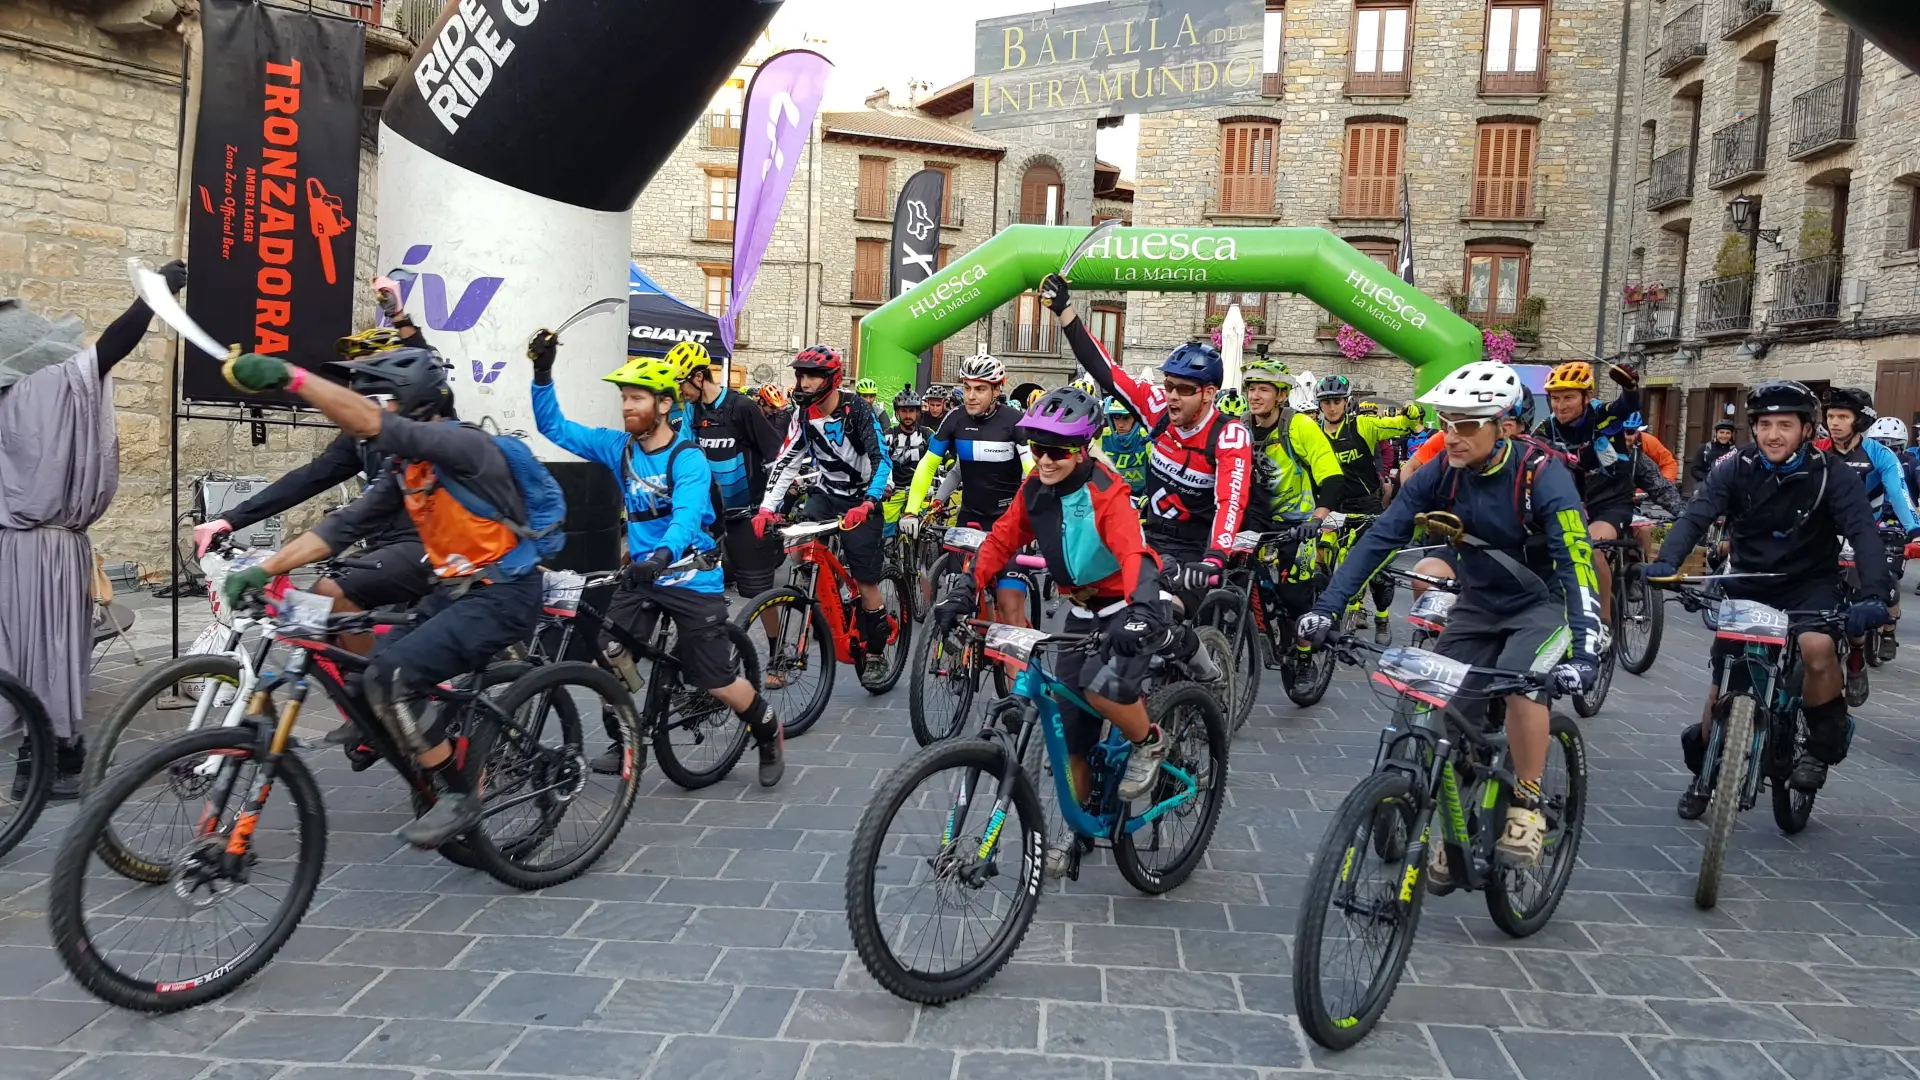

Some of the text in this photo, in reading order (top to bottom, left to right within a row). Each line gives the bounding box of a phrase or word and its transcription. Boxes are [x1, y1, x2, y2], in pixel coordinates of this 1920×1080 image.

[1001, 13, 1247, 71] BATALLA DEL
[1031, 17, 1049, 31] LA
[428, 15, 516, 135] RIDE
[980, 55, 1255, 117] INFRAMUNDO
[220, 143, 238, 260] Zona Zero Official Beer
[243, 166, 256, 242] AMBER LAGER
[254, 58, 301, 354] TRONZADORA
[1029, 830, 1042, 896] MAXXIS
[1399, 864, 1420, 903] FOX
